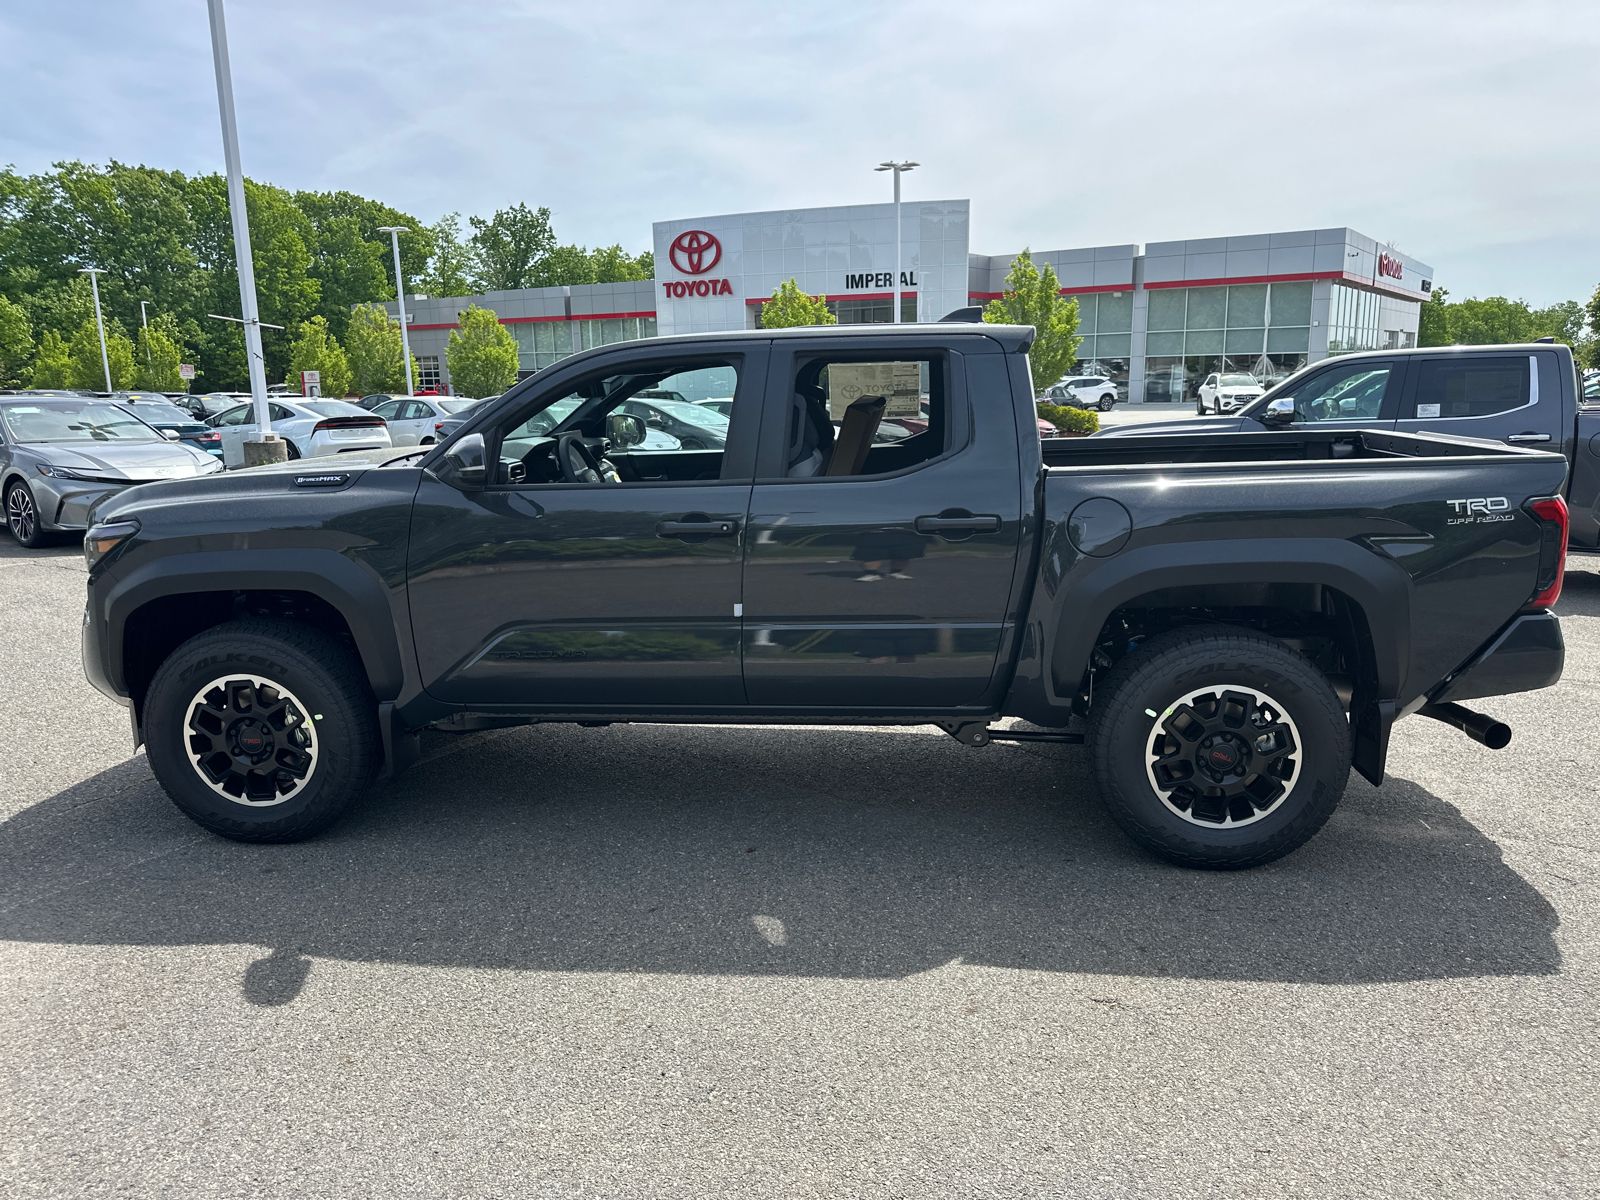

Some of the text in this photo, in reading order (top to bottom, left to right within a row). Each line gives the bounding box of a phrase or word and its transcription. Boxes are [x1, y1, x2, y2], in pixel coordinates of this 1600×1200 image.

[662, 278, 733, 299] TOYOTA
[865, 383, 907, 393] TOYOTA
[1446, 496, 1510, 516] TRD
[1446, 514, 1515, 525] OFF ROAD
[489, 650, 588, 660] TACOMA
[177, 653, 289, 684] FALKEN
[1173, 662, 1303, 692] FALKEN
[1212, 751, 1232, 763] TRD
[1203, 778, 1328, 856] WILDPEAK
